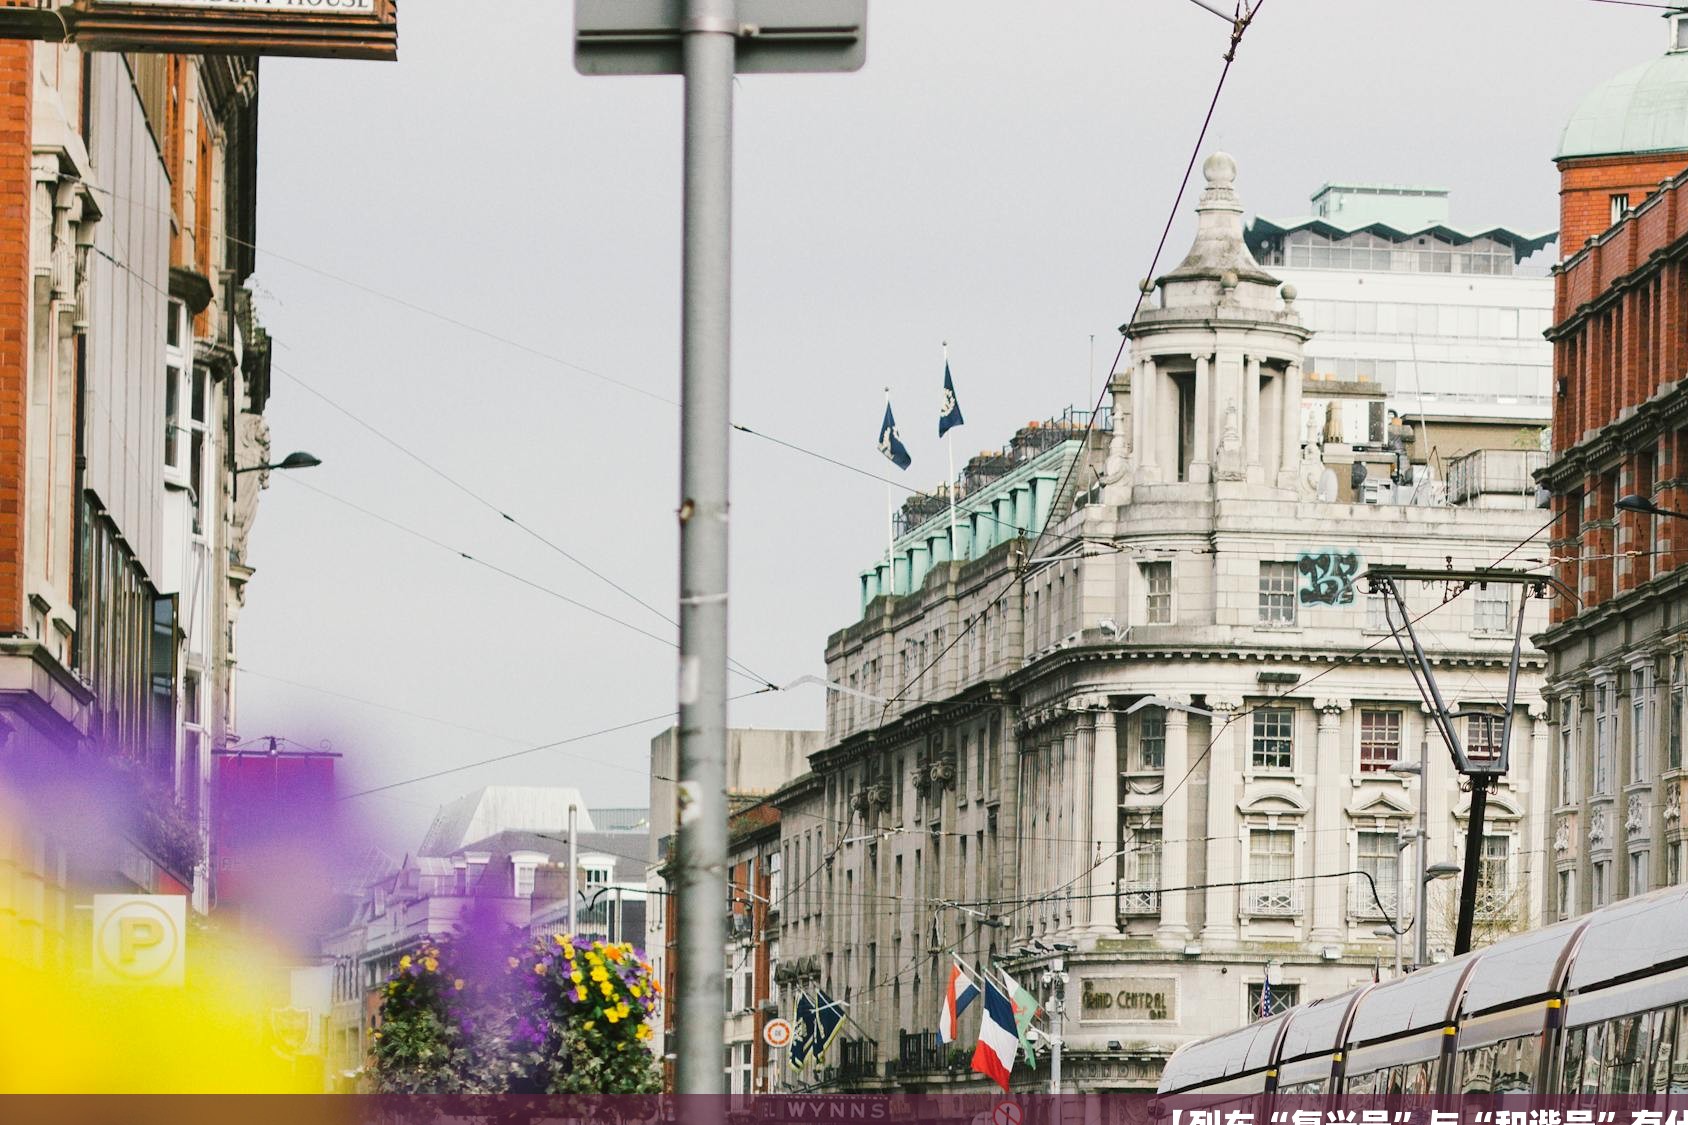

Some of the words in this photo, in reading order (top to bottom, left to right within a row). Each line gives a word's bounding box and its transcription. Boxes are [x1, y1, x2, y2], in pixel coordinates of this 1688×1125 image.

[120, 917, 165, 965] P
[1117, 990, 1167, 1010] CENTRAL
[787, 1101, 886, 1119] WYNNS
